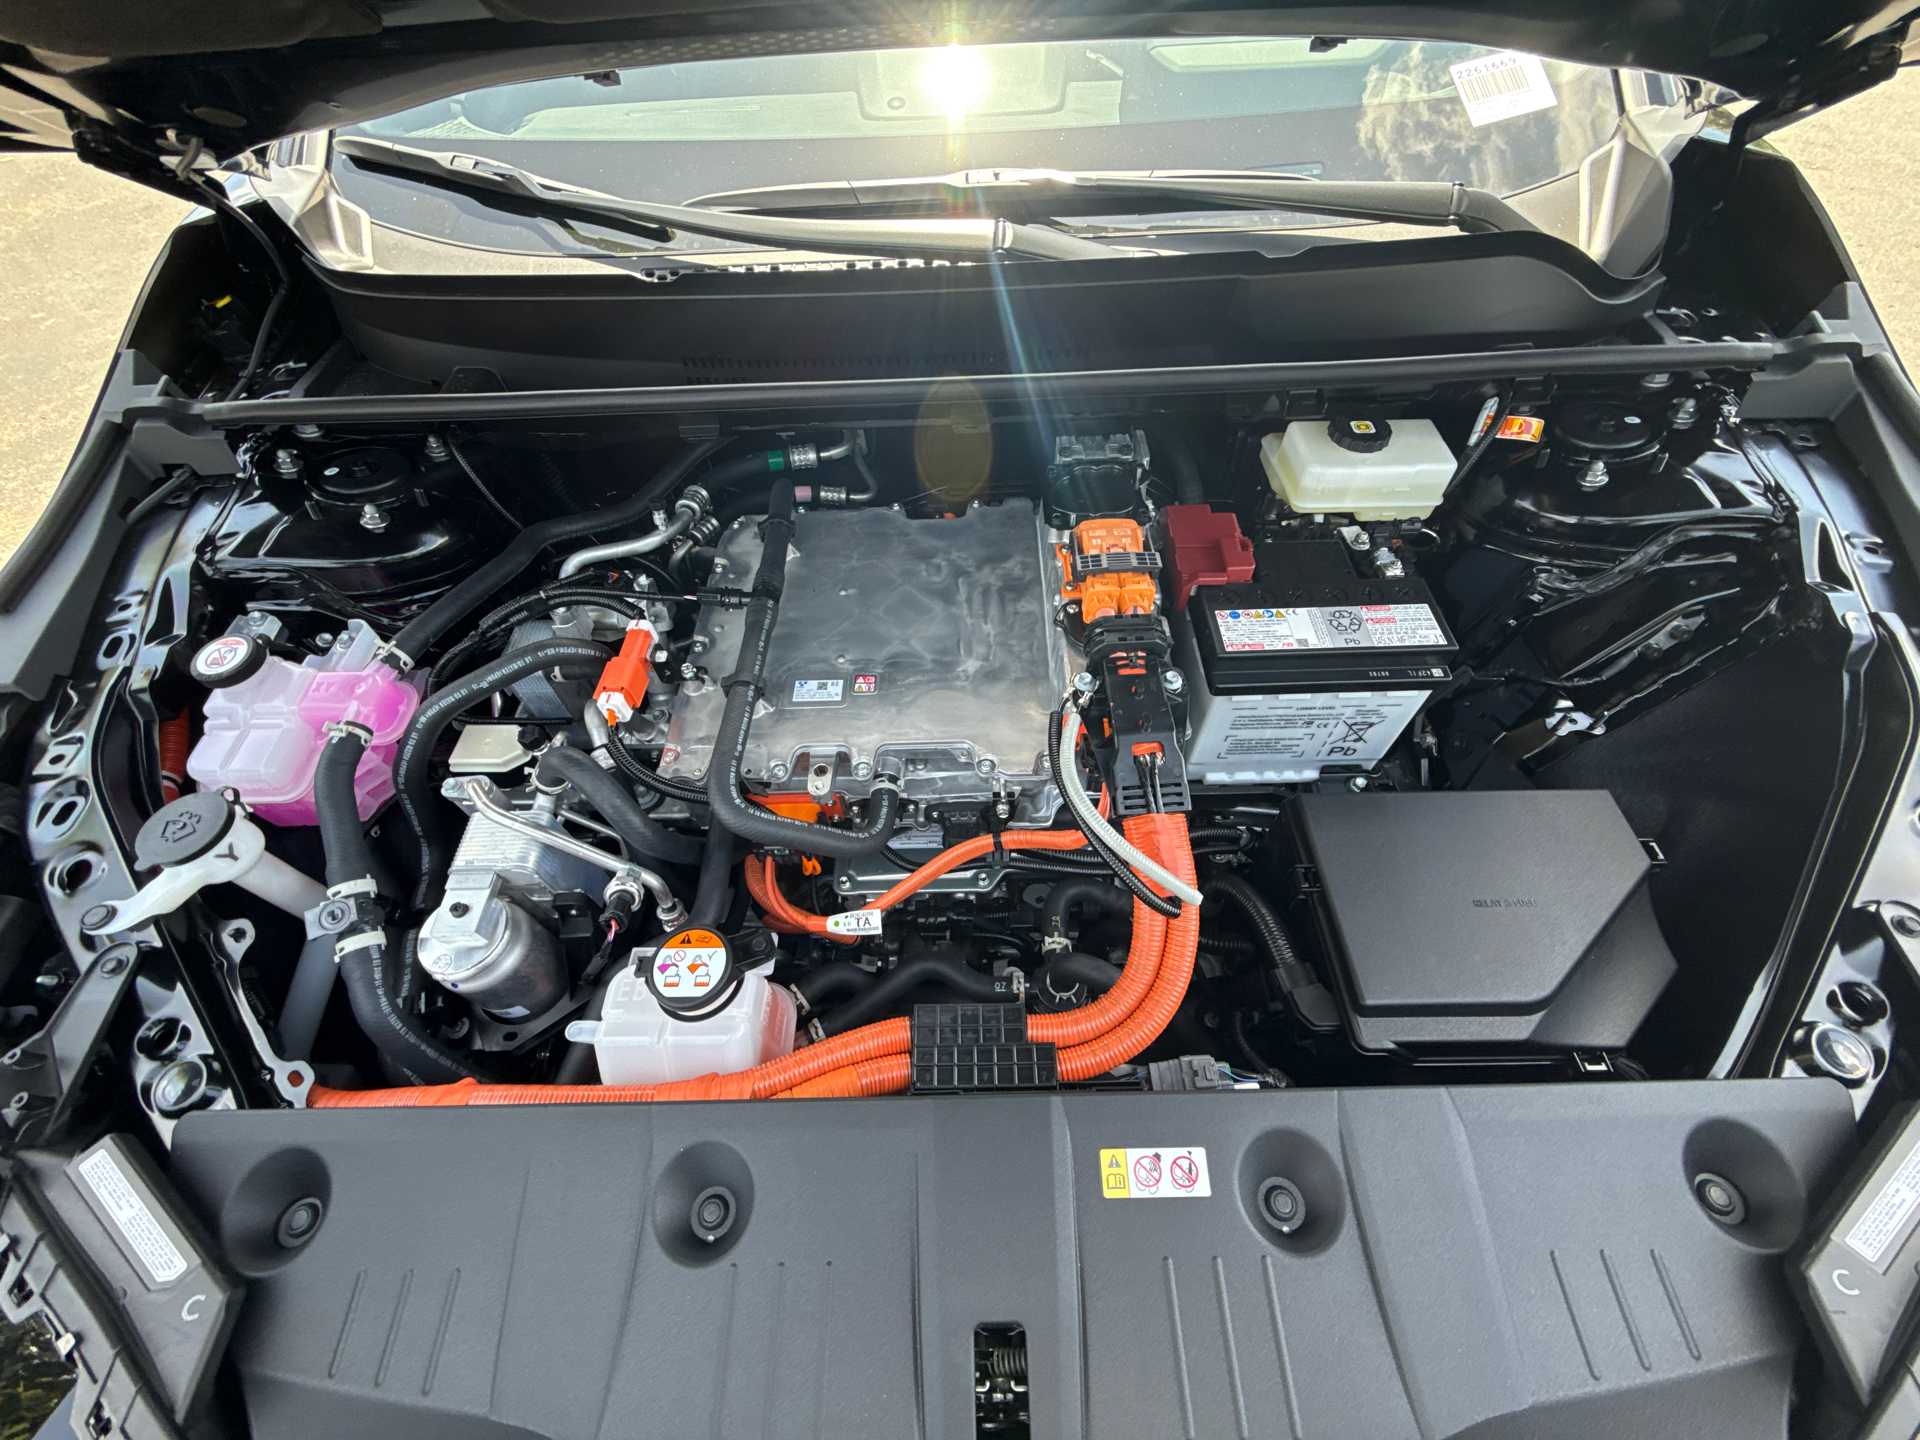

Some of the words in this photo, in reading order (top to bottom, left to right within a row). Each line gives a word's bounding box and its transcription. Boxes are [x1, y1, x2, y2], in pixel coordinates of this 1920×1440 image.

[1457, 57, 1516, 79] 2261669
[1327, 747, 1357, 756] Pb
[1472, 899, 1502, 908] RELAY
[854, 917, 871, 927] TA
[181, 1294, 206, 1322] C
